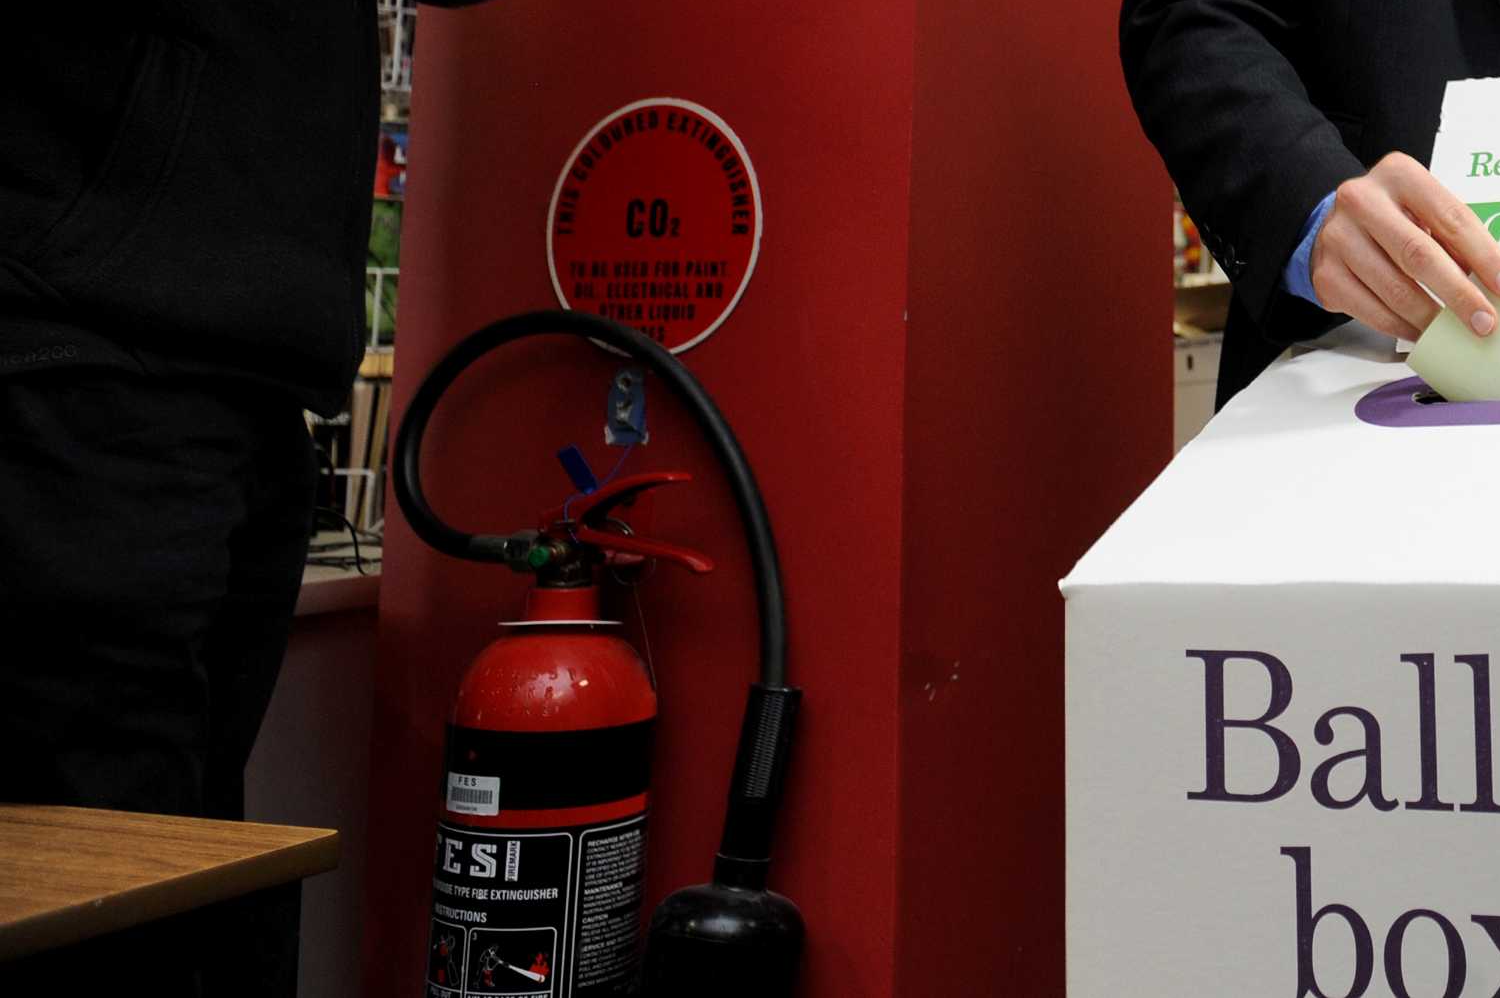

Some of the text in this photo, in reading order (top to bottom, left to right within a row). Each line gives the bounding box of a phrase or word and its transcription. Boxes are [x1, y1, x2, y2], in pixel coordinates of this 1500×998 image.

[557, 110, 751, 235] THIS COLOURED EXTINGUISHER
[686, 261, 728, 276] PAINT
[607, 283, 690, 299] ELECTRICAL
[695, 283, 723, 299] AND
[649, 304, 696, 320] LIQUID
[454, 885, 470, 898] TYPE
[490, 888, 559, 901] EXTINGUISHER
